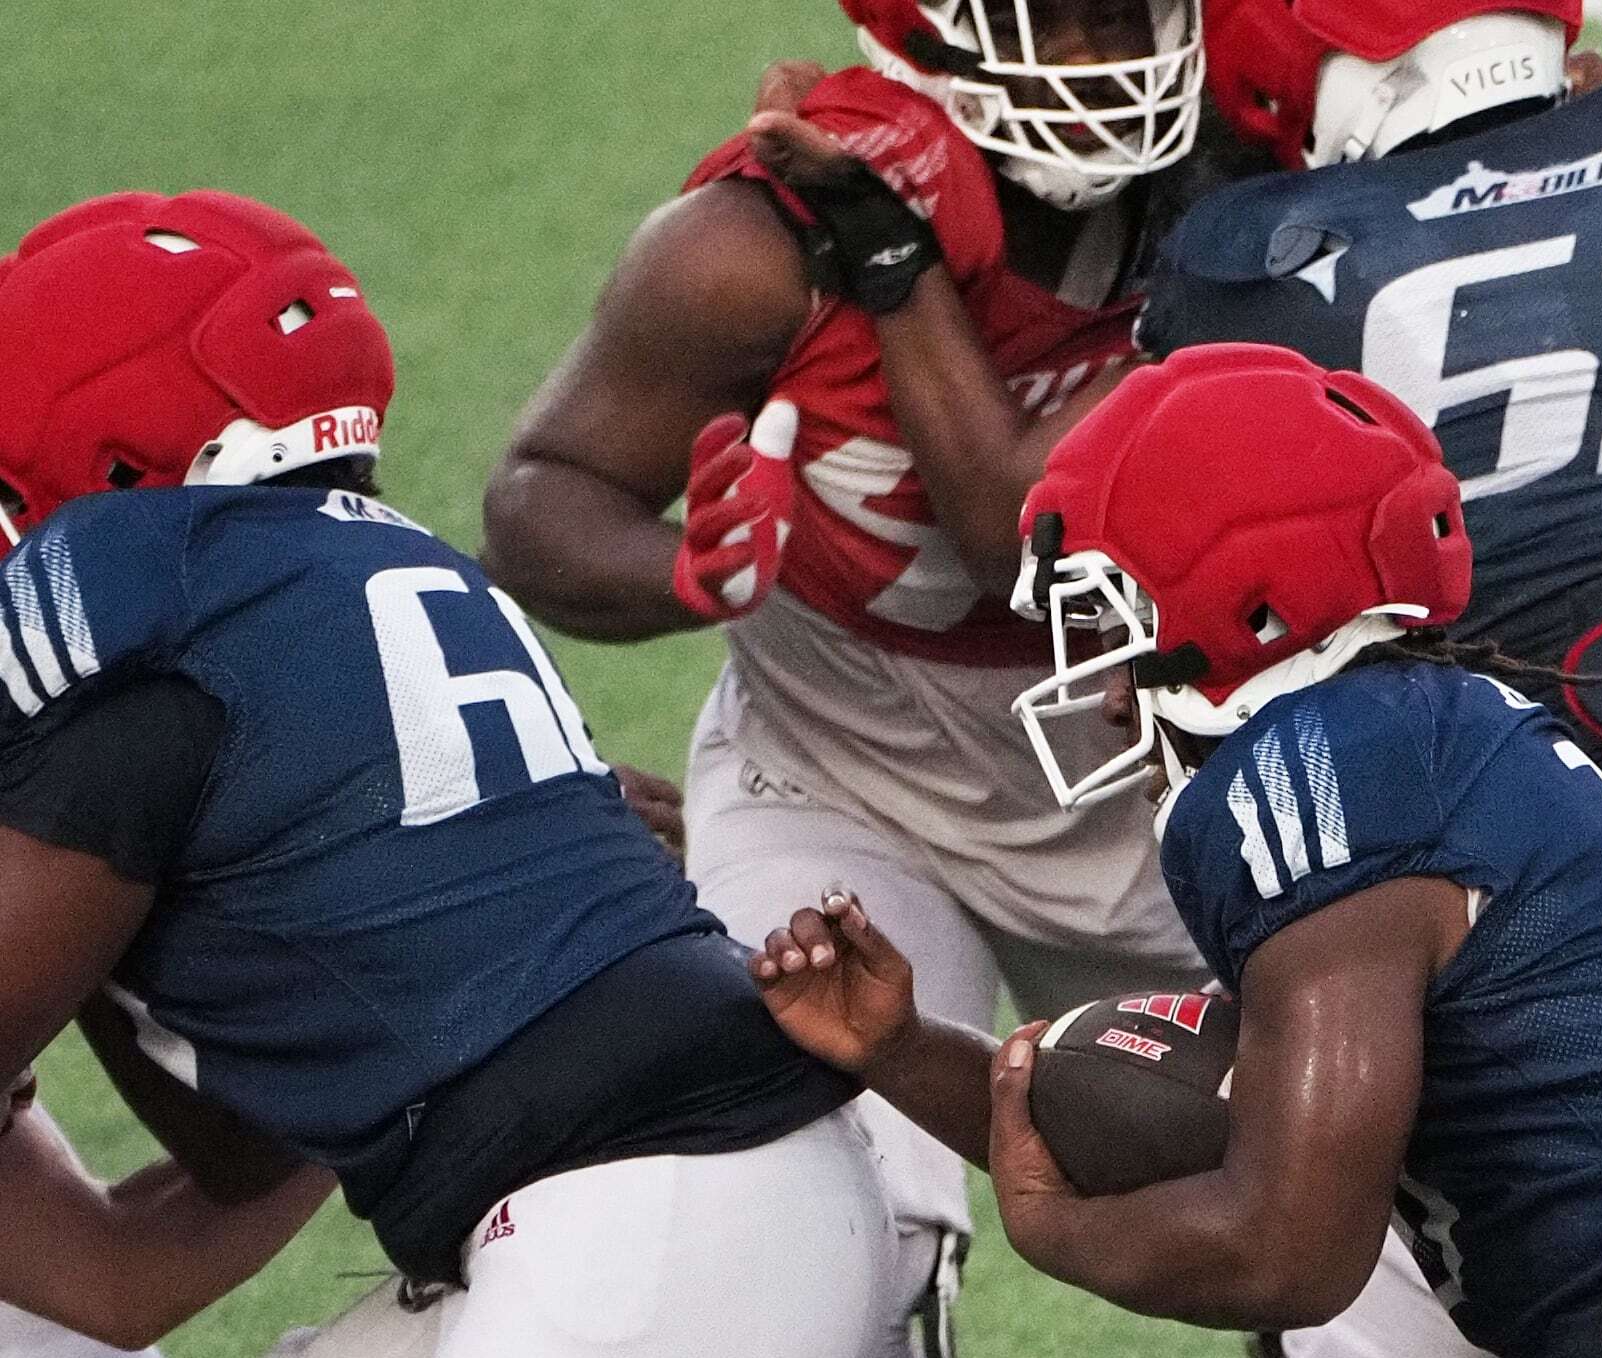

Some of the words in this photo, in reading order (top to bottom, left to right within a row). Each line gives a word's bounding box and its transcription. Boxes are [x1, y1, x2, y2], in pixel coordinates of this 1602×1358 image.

[1450, 57, 1535, 97] VICIS
[312, 409, 379, 453] Ridd
[1104, 1031, 1164, 1059] DIME
